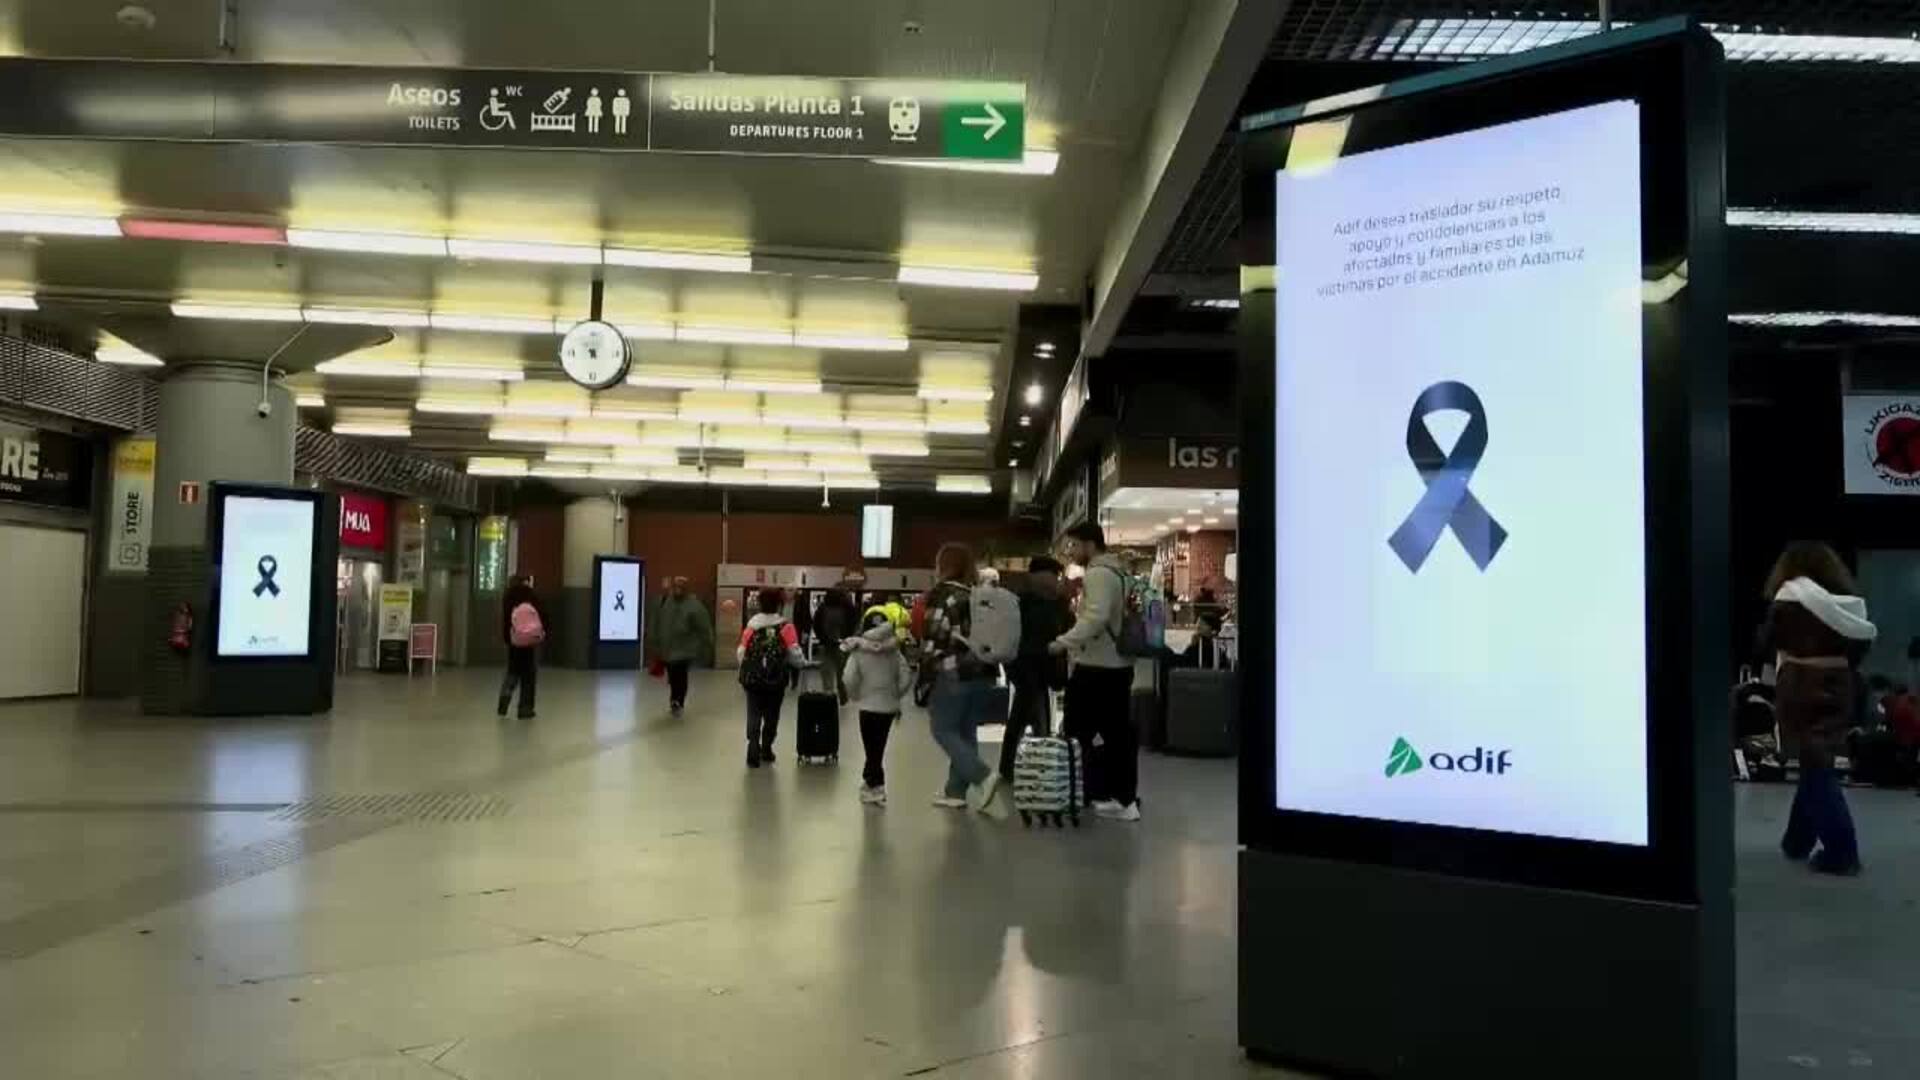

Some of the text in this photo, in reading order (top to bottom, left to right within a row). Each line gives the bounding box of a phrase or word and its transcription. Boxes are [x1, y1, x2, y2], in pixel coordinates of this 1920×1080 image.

[385, 82, 461, 107] Aseos
[505, 85, 523, 97] WC
[670, 89, 865, 116] Salidas Planta 1
[408, 116, 460, 131] TOILETS
[730, 124, 864, 139] DEPARTURES FLOOR 1
[1333, 186, 1561, 236] Adif desea trasladar su respeto
[1349, 209, 1545, 254] apoyo y condolencias a los
[1343, 230, 1552, 274] afectados y familiares de las
[1377, 275, 1400, 292] por
[1403, 271, 1417, 286] el
[1420, 260, 1494, 282] accidente
[1497, 257, 1517, 272] en
[1520, 247, 1585, 269] Adamuz
[1169, 437, 1219, 468] las
[125, 491, 140, 535] STORE
[1429, 746, 1513, 775] adif
